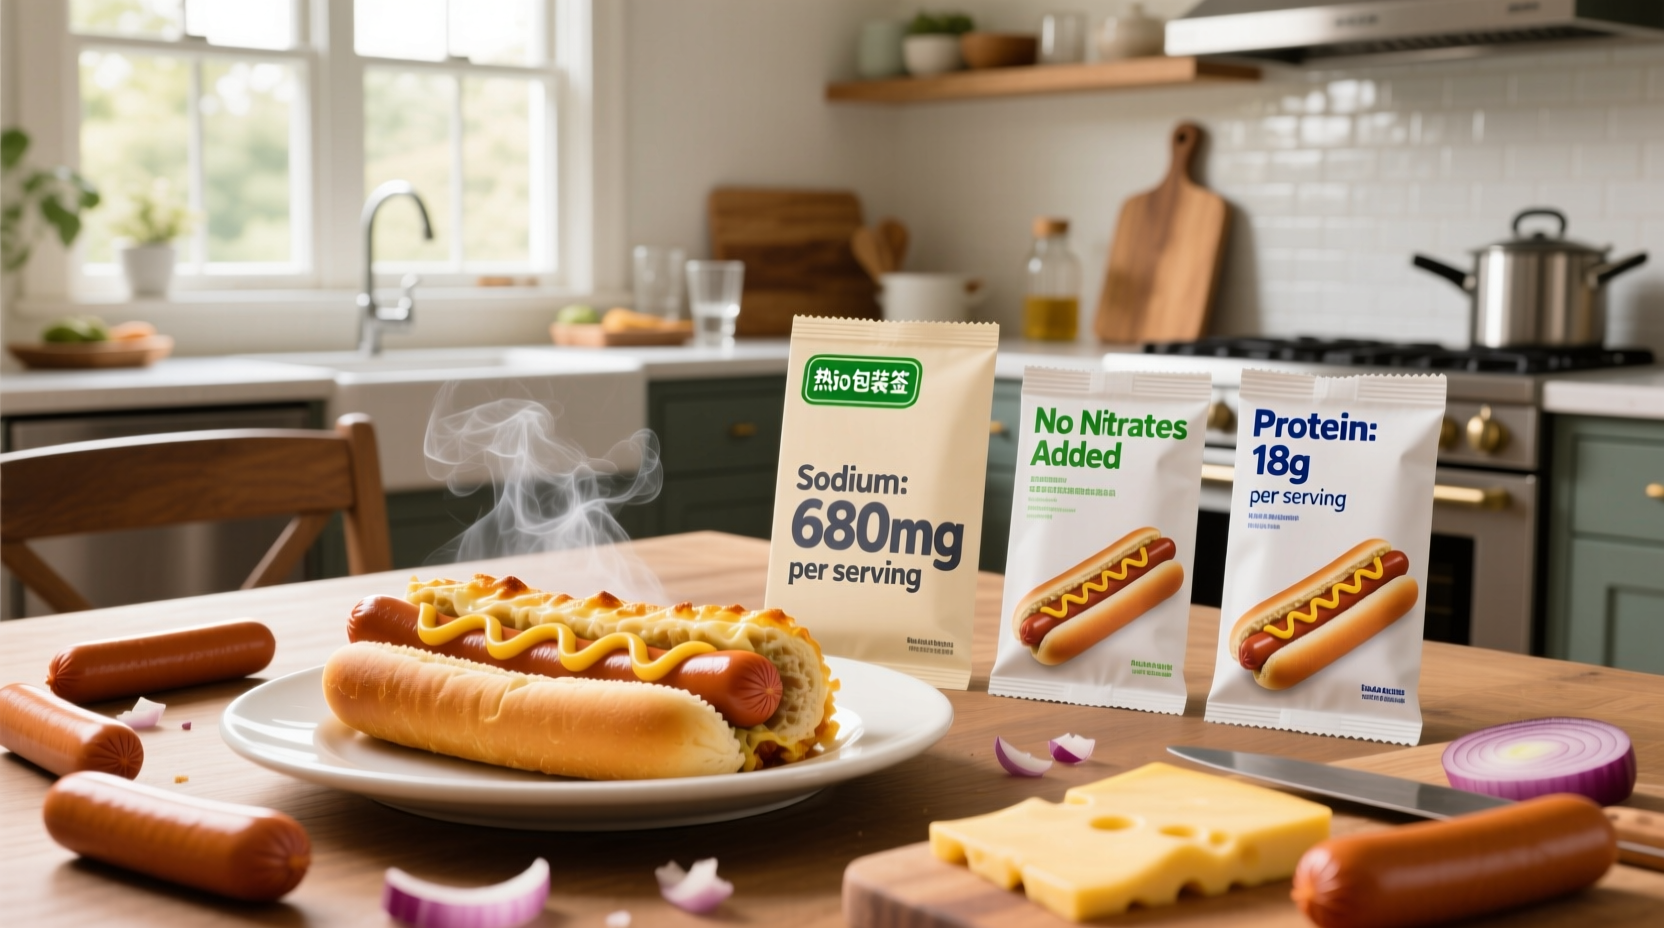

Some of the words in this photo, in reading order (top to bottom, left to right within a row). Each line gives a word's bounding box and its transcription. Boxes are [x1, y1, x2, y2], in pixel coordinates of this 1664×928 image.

[1034, 407, 1074, 435] No
[1080, 409, 1188, 440] Nitrates
[1253, 408, 1377, 442] Protein:
[1030, 439, 1122, 469] Added
[1252, 444, 1311, 485] 18g
[796, 464, 909, 495] Sodium:
[1249, 489, 1280, 508] per
[1282, 489, 1347, 512] serving
[791, 498, 965, 572] 680mg
[788, 561, 828, 585] per
[832, 560, 922, 593] serving
